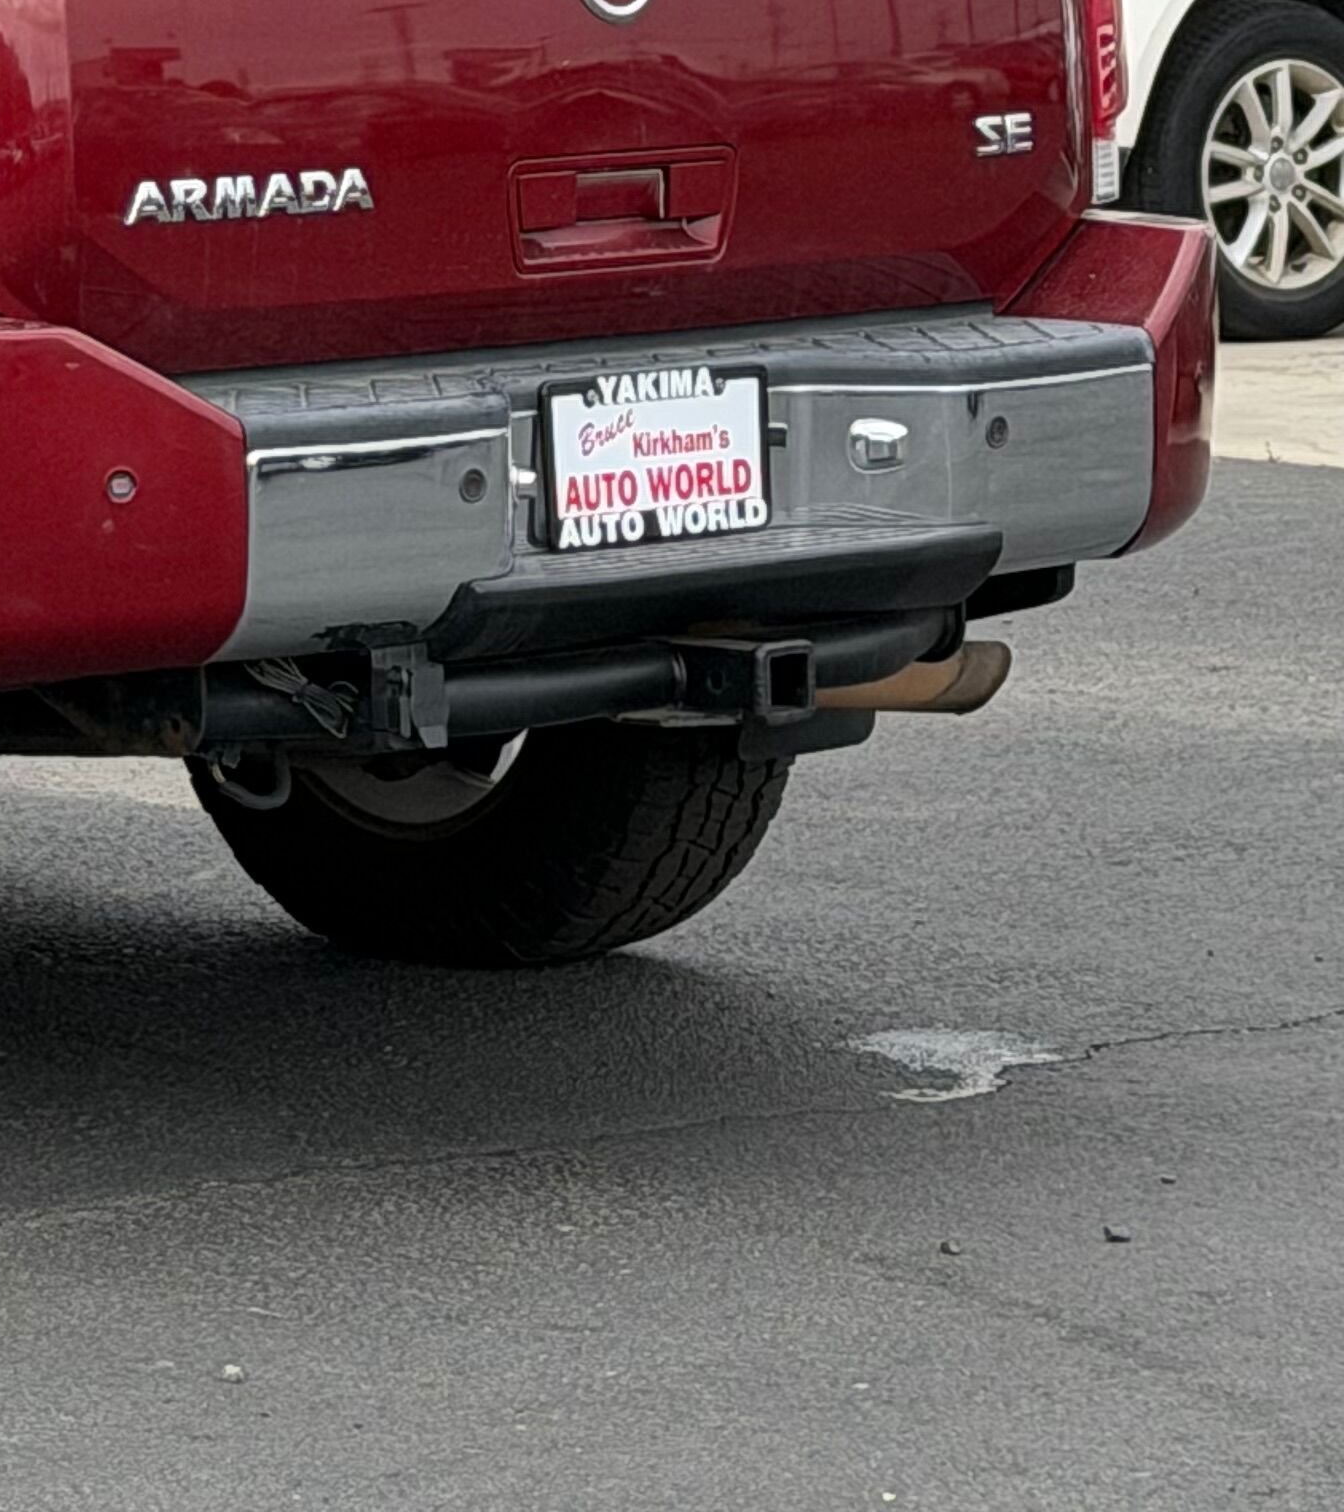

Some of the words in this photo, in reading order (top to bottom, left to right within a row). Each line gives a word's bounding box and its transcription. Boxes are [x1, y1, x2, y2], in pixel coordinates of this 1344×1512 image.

[975, 112, 1033, 157] SE
[123, 167, 375, 225] ARMADA
[596, 367, 714, 405] YAKIMA
[578, 408, 635, 456] Bruce
[632, 425, 730, 458] Kirkham's
[565, 470, 638, 514] AUTO
[646, 459, 752, 502] WORLD
[559, 510, 644, 549] AUTO
[656, 497, 768, 537] WORLD
